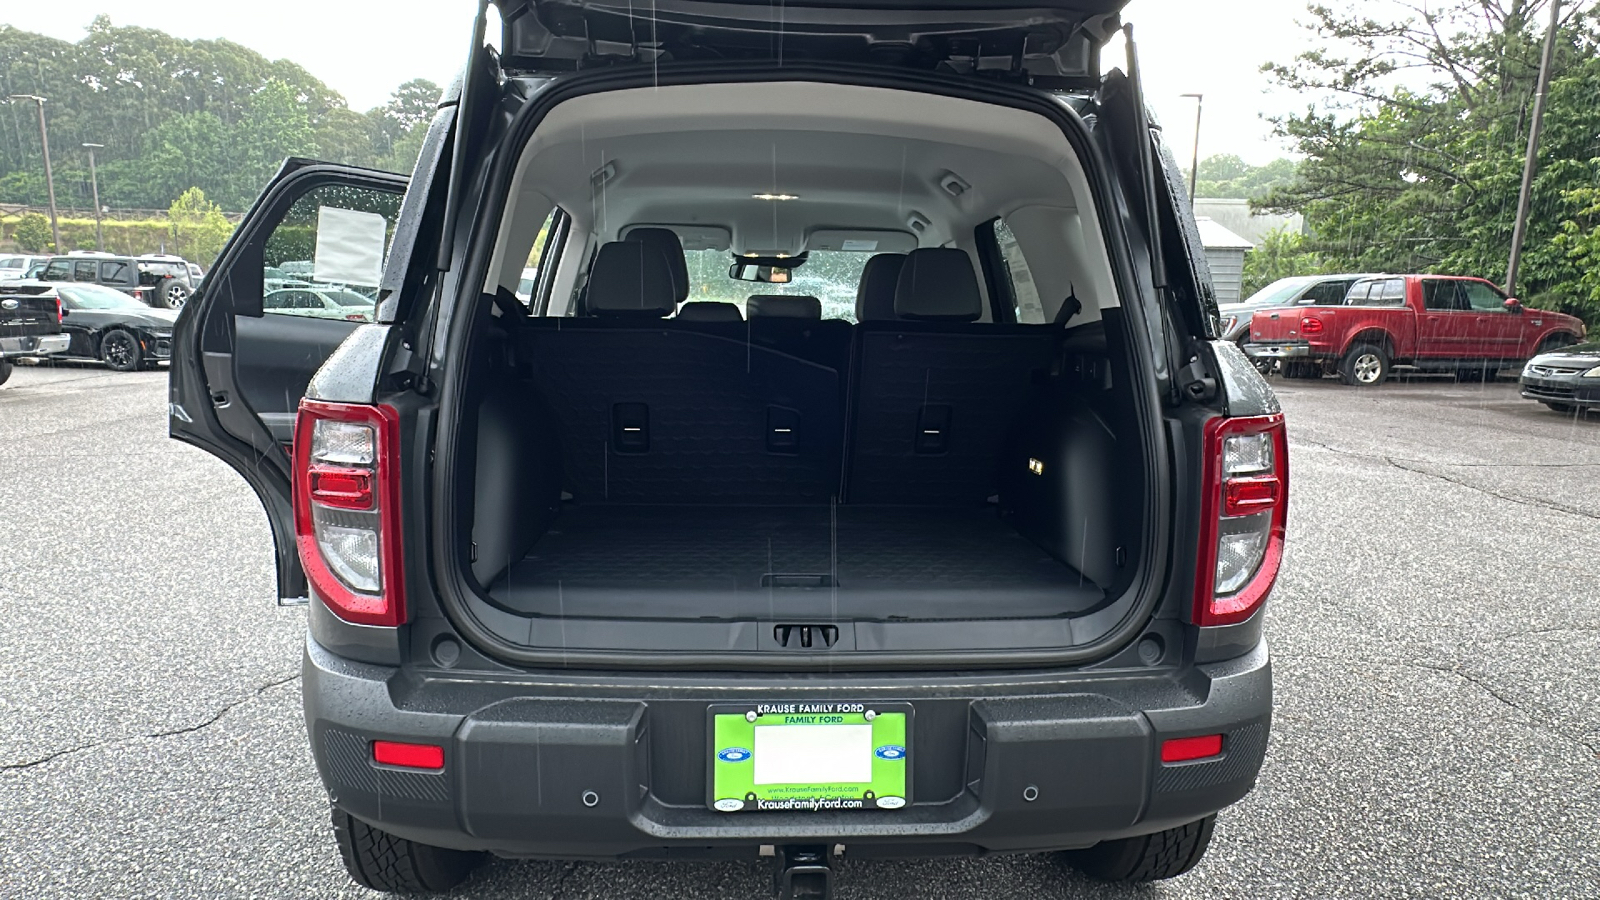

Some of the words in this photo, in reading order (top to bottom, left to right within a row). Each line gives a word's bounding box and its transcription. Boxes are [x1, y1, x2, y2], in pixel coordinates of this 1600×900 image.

[757, 704, 796, 713] KRAUSE
[799, 704, 834, 713] FAMILY
[837, 703, 864, 713] FORD
[784, 716, 816, 724] FAMILY
[767, 785, 859, 795] www.KrauseFamilyFord.com
[757, 797, 863, 811] KrauseFamilyFord.com
